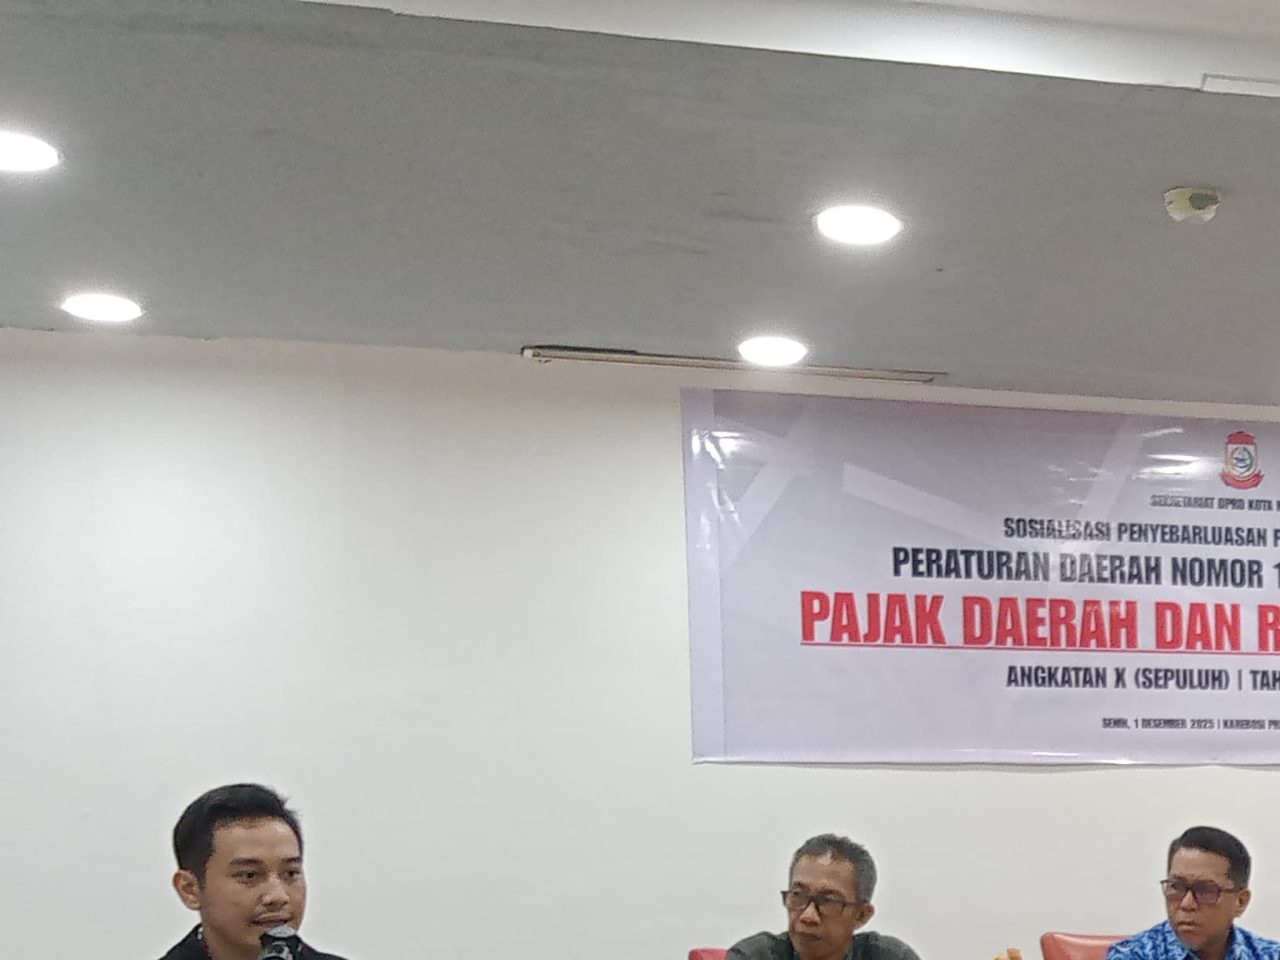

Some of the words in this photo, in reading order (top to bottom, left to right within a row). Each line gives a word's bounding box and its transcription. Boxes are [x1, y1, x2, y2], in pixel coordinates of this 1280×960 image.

[1217, 497, 1245, 510] DPRD
[1248, 498, 1273, 511] KOTA
[1003, 517, 1111, 543] SOSIALISASI
[1117, 522, 1267, 548] PENYEBARLUASAN
[893, 547, 1050, 582] PERATURAN
[1060, 552, 1162, 585] DAERAH
[1171, 557, 1263, 588] NOMOR
[801, 590, 946, 645] PAJAK
[962, 596, 1138, 650] DAERAH
[1155, 602, 1241, 651] DAN
[1006, 666, 1107, 689] ANGKATAN
[1114, 668, 1128, 689] X
[1134, 667, 1230, 691] (SEPULUH)
